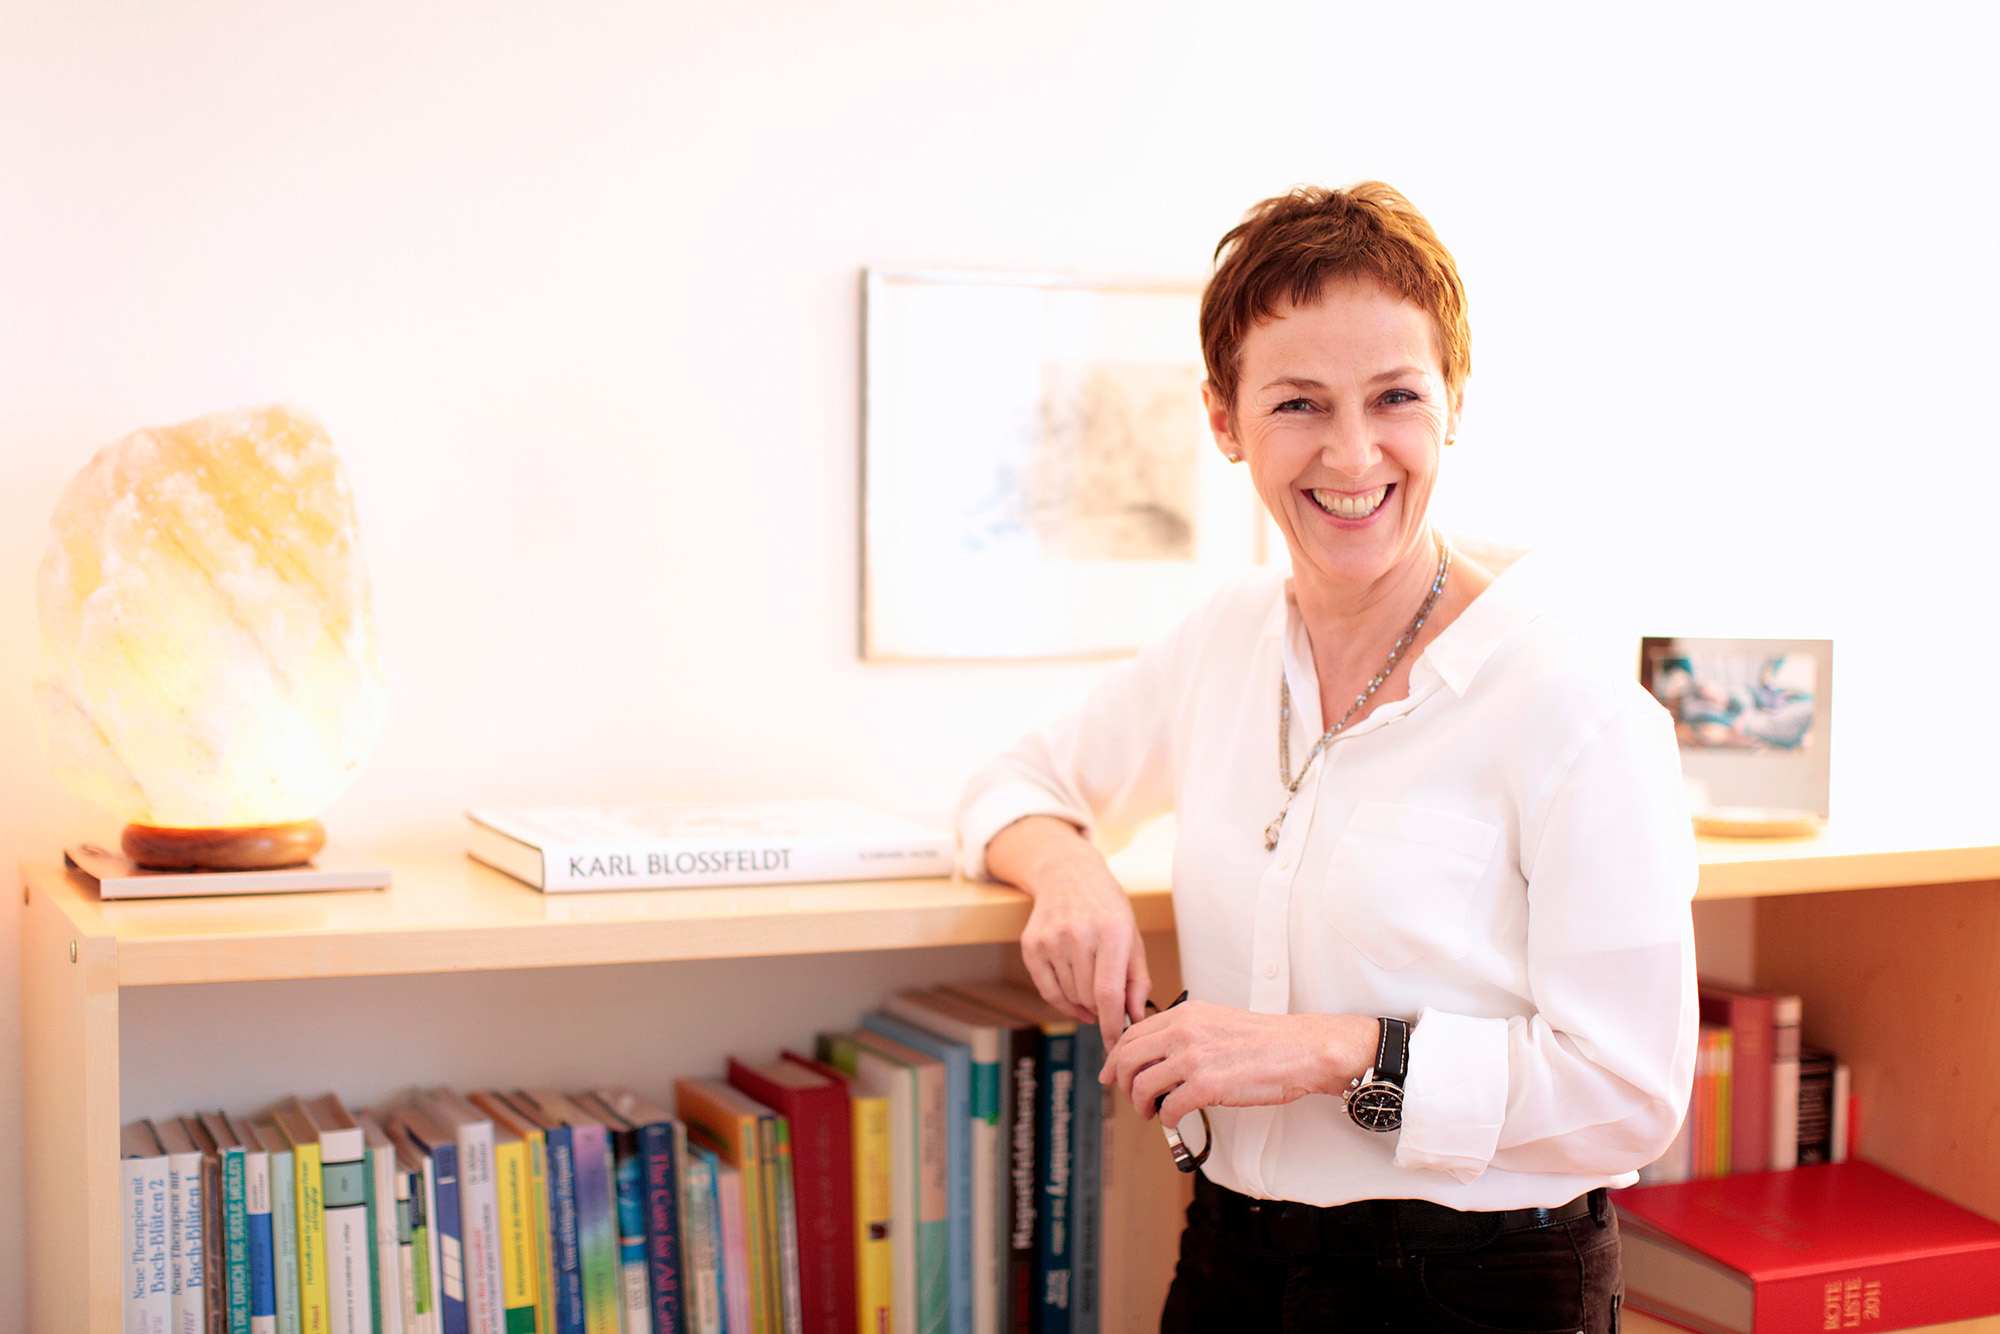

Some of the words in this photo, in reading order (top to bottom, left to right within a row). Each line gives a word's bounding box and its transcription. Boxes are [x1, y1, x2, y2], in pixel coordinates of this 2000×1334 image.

[569, 852, 638, 878] KARL
[648, 850, 790, 874] BLOSSFELDT
[649, 1153, 670, 1186] The
[1013, 1056, 1037, 1249] Magnetfeldtherapie
[131, 1176, 144, 1195] mit
[149, 1179, 163, 1190] 2
[169, 1171, 180, 1189] mit
[170, 1194, 183, 1258] Therapien
[650, 1189, 672, 1231] Cure
[131, 1198, 148, 1264] Therapien
[149, 1192, 166, 1293] Bach-Blüten
[185, 1187, 203, 1288] Bach-Blüten
[655, 1235, 675, 1258] for
[132, 1268, 145, 1299] Neue
[170, 1264, 182, 1295] Neue
[656, 1262, 678, 1291] All
[1823, 1279, 1843, 1330] ROTE
[1843, 1276, 1862, 1327] LISTE
[1862, 1281, 1881, 1320] 2011
